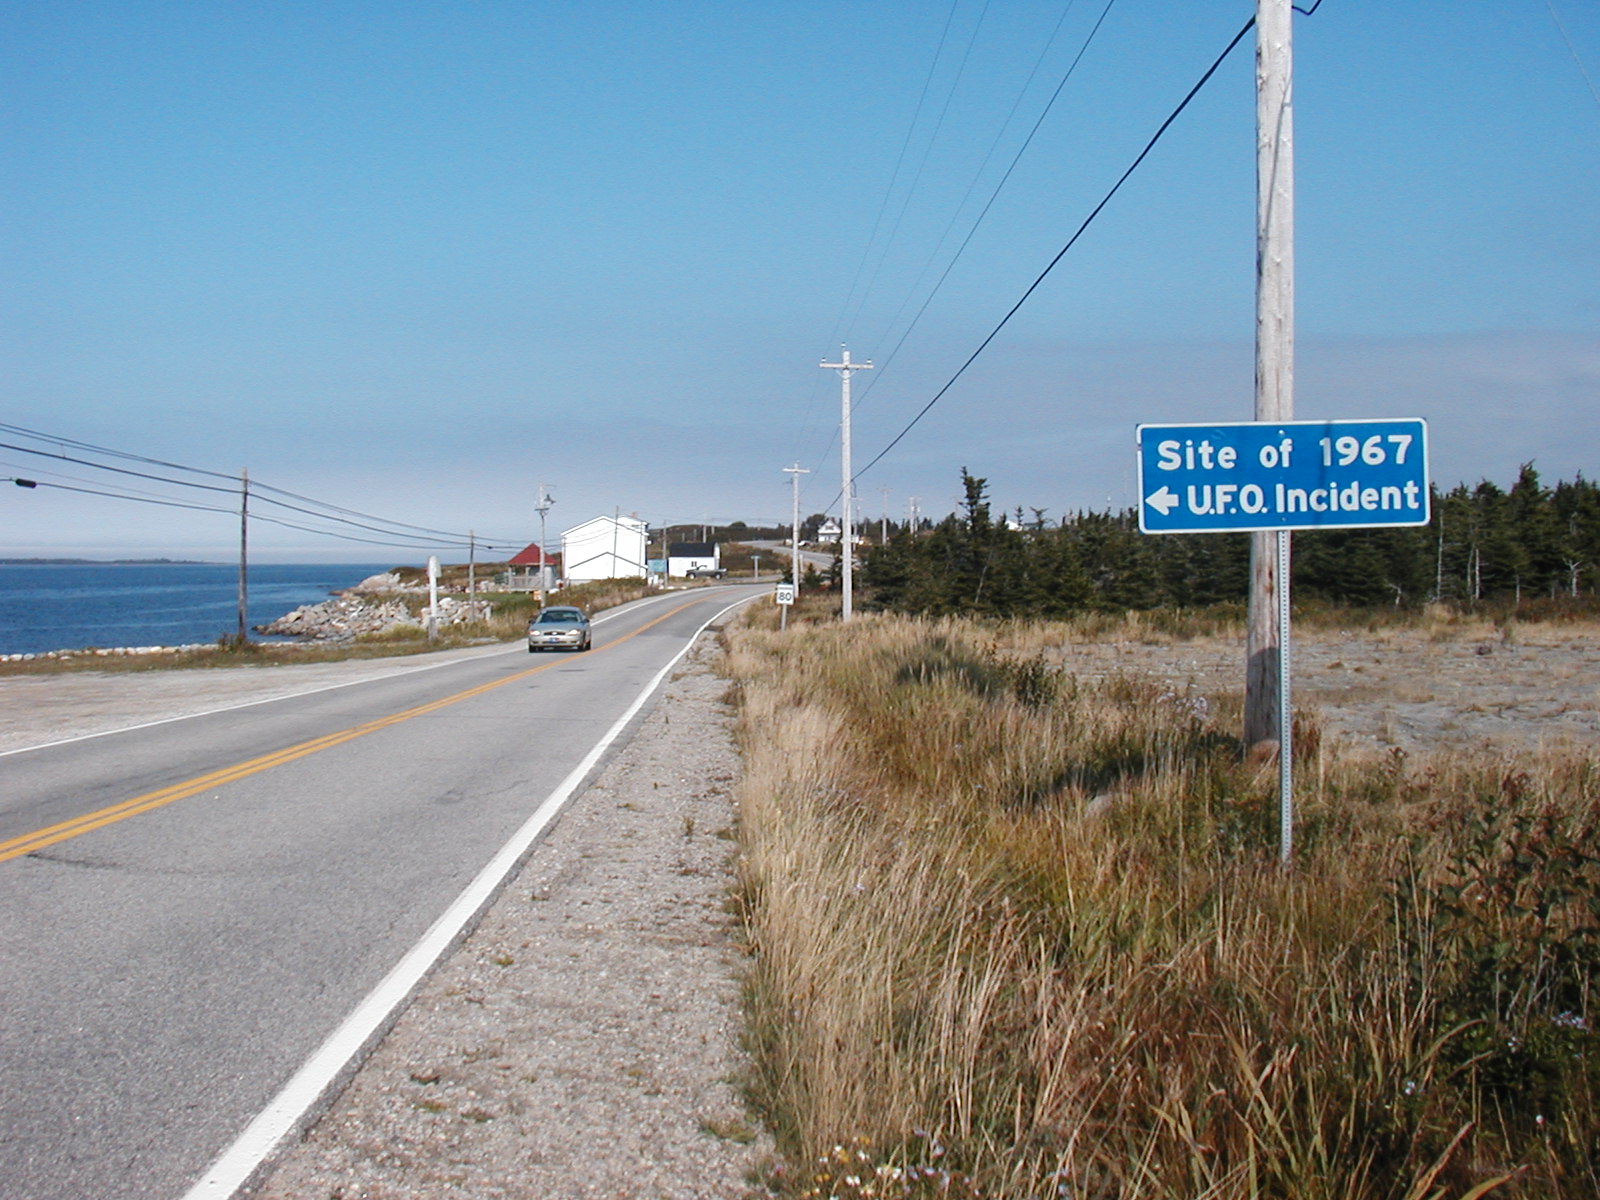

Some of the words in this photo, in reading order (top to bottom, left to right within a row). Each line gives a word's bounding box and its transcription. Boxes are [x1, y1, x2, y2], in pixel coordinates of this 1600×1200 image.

[1157, 440, 1237, 470] Site
[1259, 438, 1293, 468] of
[1319, 434, 1413, 467] 1967
[1187, 483, 1268, 515] U.F.O.
[1275, 480, 1420, 513] Incident
[779, 592, 792, 601] 80
